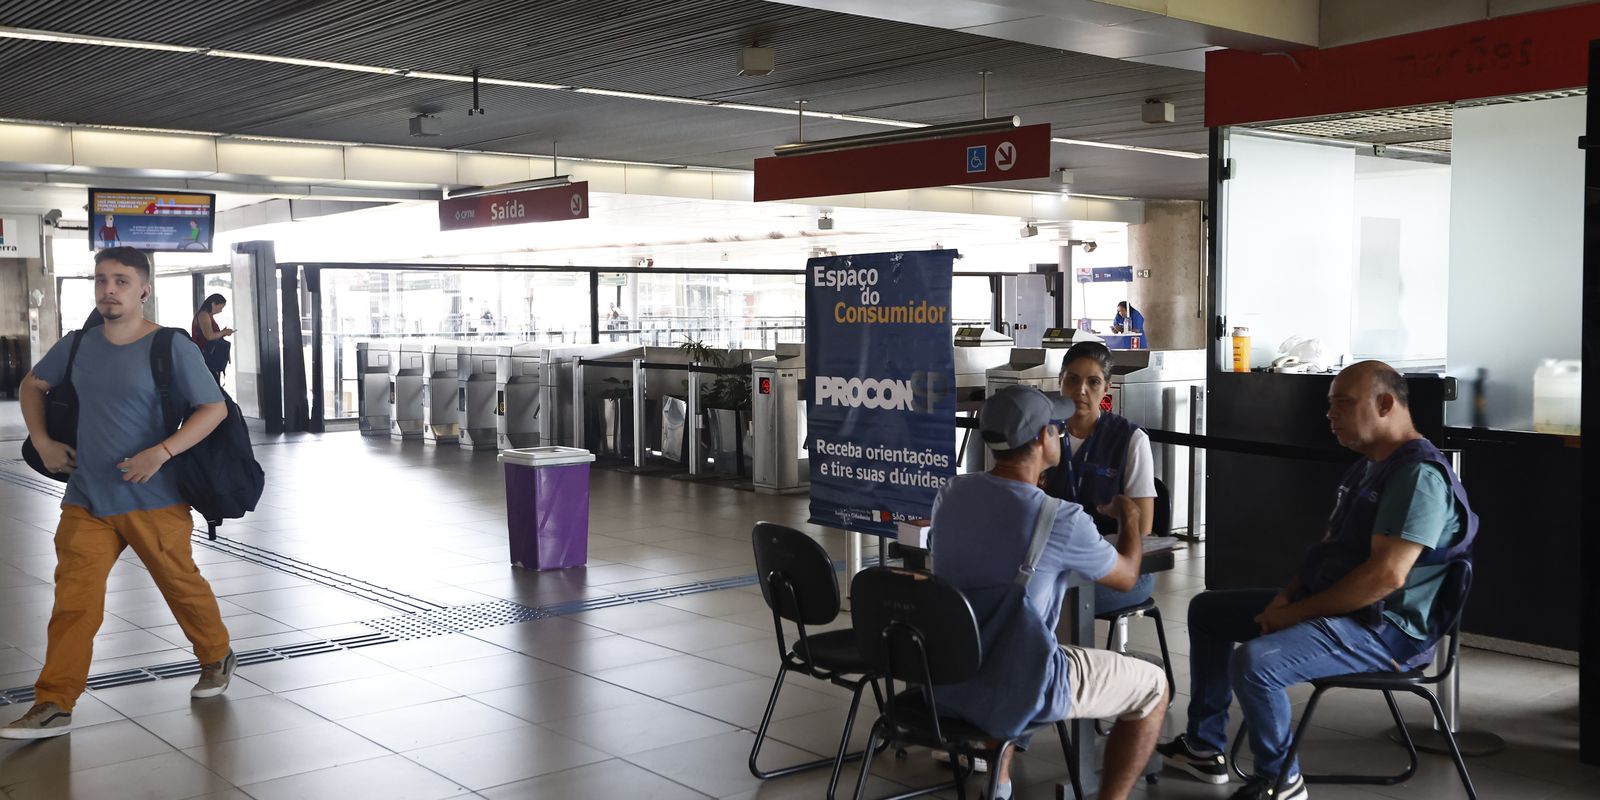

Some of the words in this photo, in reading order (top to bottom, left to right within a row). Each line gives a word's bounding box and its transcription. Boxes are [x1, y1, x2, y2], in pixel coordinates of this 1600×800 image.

[491, 200, 525, 221] Saída
[814, 266, 878, 291] Espaço
[861, 287, 880, 305] do
[834, 300, 946, 324] Consumidor
[815, 376, 914, 411] PROCON
[816, 439, 862, 459] Receba
[866, 445, 949, 468] orientações
[820, 462, 828, 475] e
[831, 461, 853, 478] tire
[856, 466, 885, 483] suas
[889, 467, 947, 489] dúvidas
